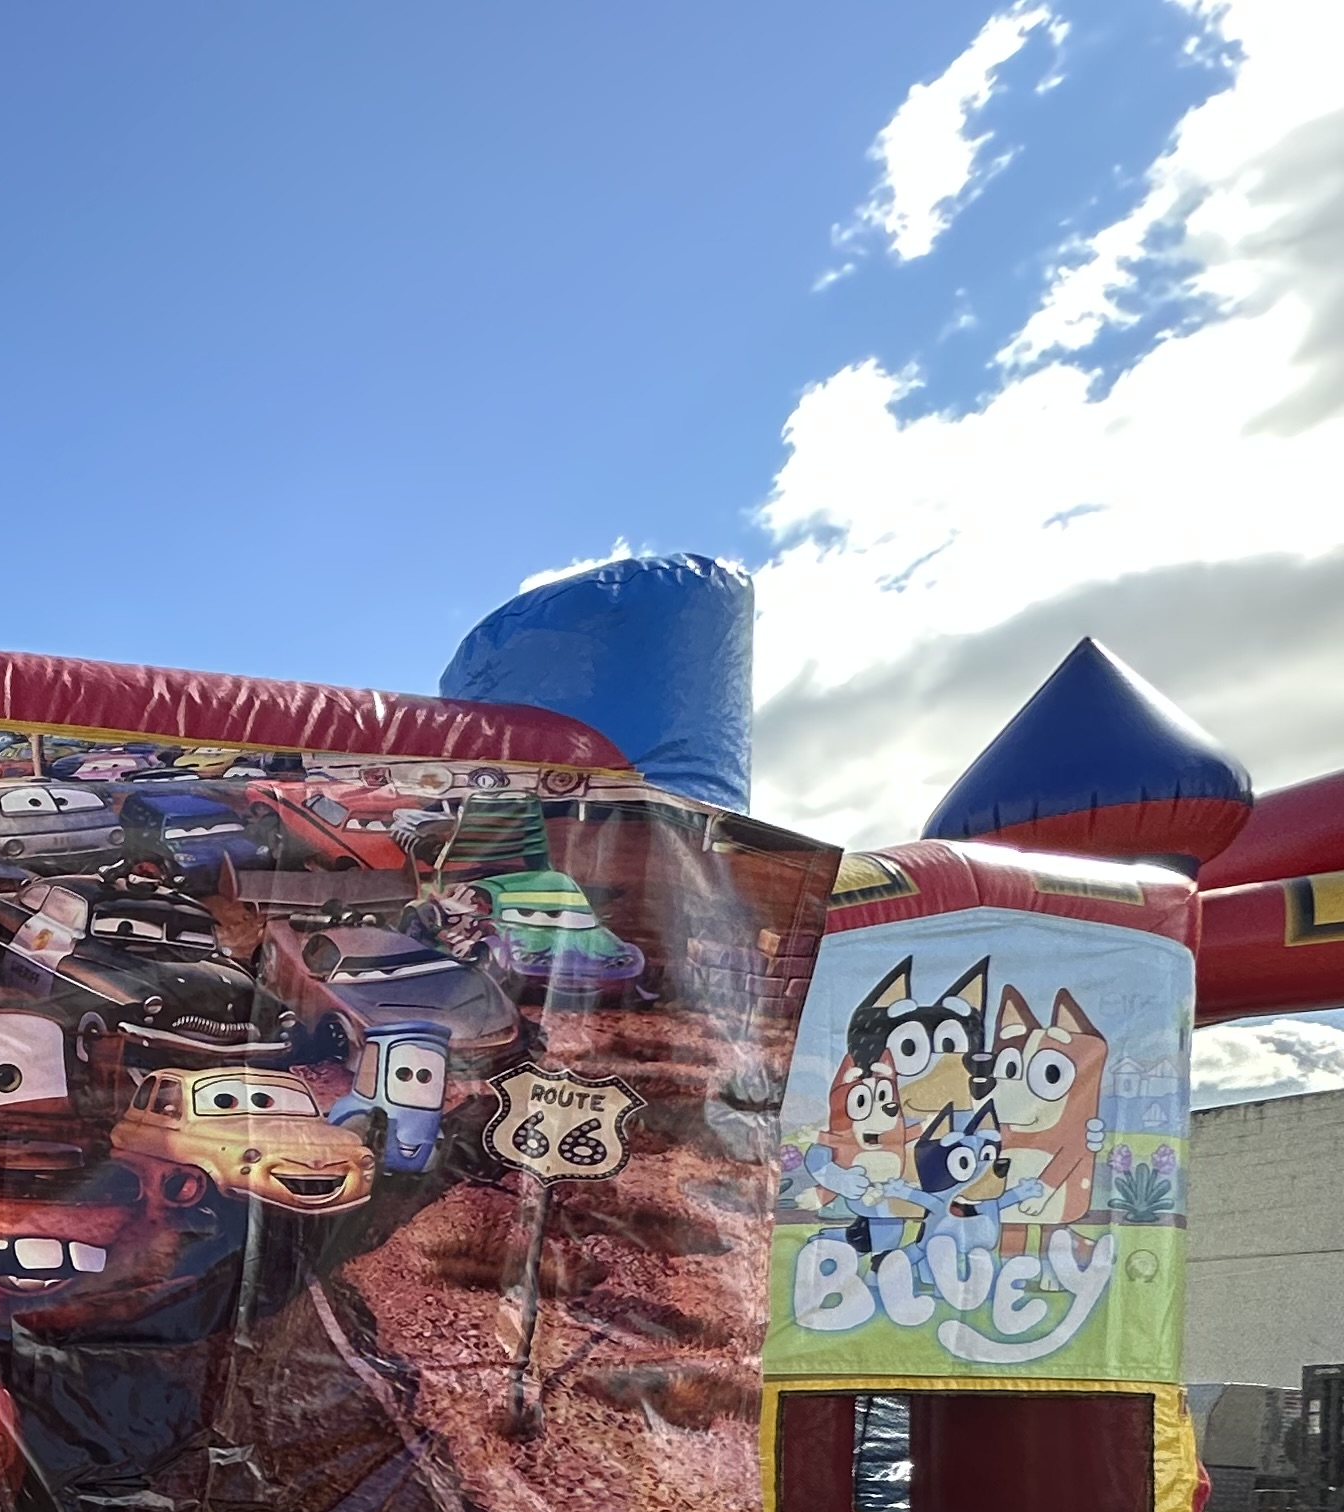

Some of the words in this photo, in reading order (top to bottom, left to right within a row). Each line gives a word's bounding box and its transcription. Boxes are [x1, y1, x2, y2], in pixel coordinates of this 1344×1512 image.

[530, 1083, 607, 1113] ROUTE
[512, 1110, 608, 1167] 66
[793, 1227, 1114, 1364] BLUEY
